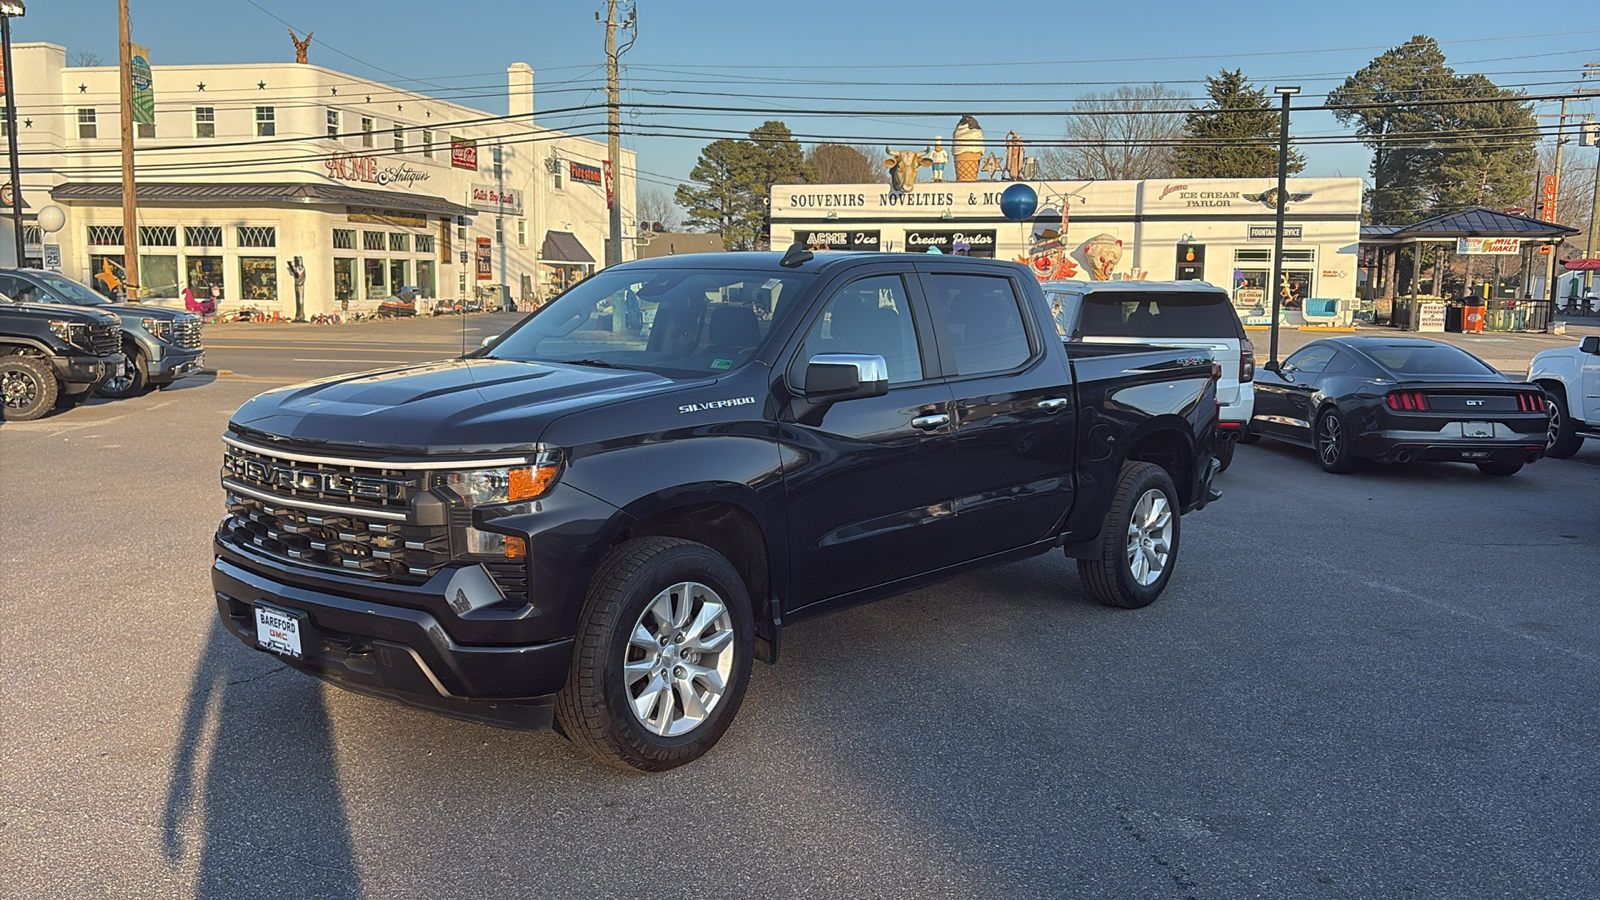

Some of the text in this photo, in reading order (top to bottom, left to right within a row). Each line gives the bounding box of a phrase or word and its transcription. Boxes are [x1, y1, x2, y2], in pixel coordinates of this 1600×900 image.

[325, 151, 430, 188] ACME Antiques
[570, 162, 601, 182] Firestone
[473, 188, 488, 201] Dutch
[489, 190, 498, 205] Boy
[790, 194, 865, 208] SOUVENIRS
[879, 193, 954, 207] NOVELTIES
[967, 192, 978, 206] &
[1180, 191, 1240, 200] ICE CREAM
[1186, 200, 1232, 208] PARLOR
[806, 232, 878, 245] ACME Ice
[908, 232, 993, 245] Cream Parlor
[47, 255, 59, 265] 25
[679, 396, 756, 413] SILVERADO
[224, 452, 416, 501] CHEVROLET
[260, 613, 296, 634] BAREFORD
[269, 629, 289, 641] GMC
